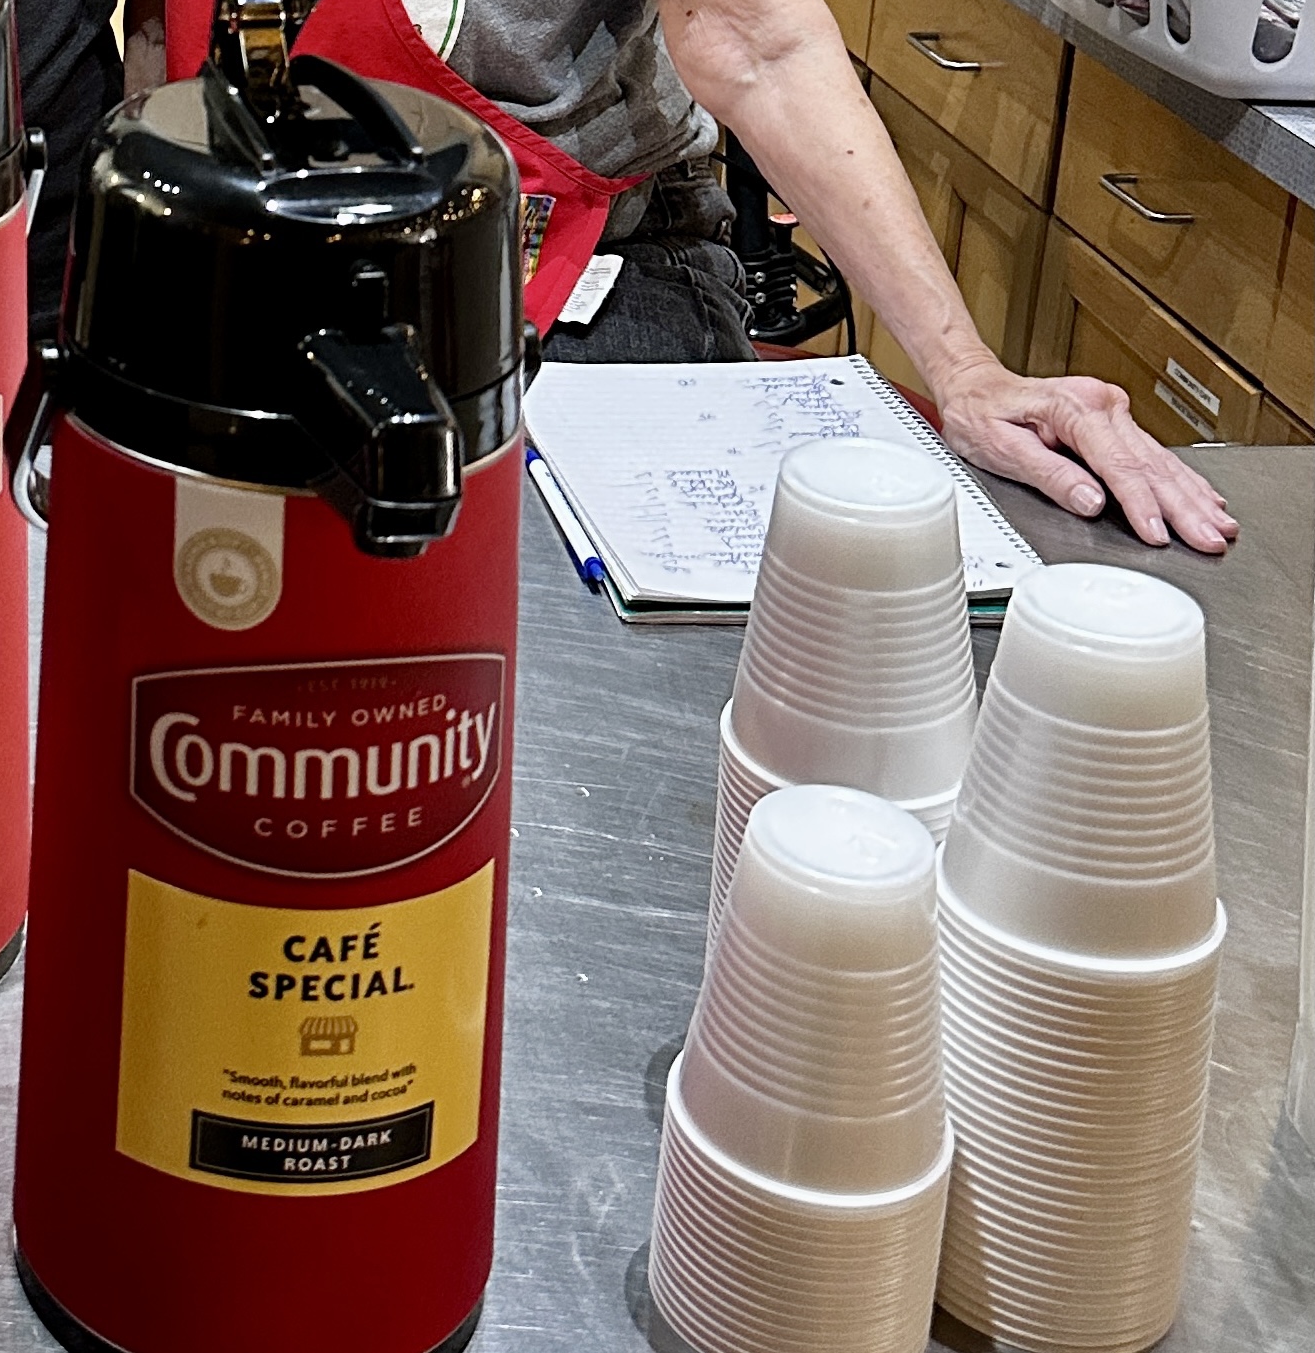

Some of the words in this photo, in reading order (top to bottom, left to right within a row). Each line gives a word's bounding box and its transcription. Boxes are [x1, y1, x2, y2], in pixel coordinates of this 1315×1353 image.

[233, 704, 337, 728] FAMILY
[350, 693, 447, 727] OWNED
[149, 701, 497, 802] Community
[254, 806, 424, 839] COFFEE
[283, 922, 383, 964] CAFÉ
[289, 1075, 349, 1090] flavorful
[351, 1069, 388, 1086] blend
[391, 1063, 417, 1079] with
[222, 1089, 262, 1104] notes
[264, 1092, 280, 1105] of
[282, 1092, 341, 1106] caramel
[343, 1089, 369, 1104] and
[242, 1129, 393, 1153] MEDIUM-DARK
[284, 1155, 352, 1171] ROAST
